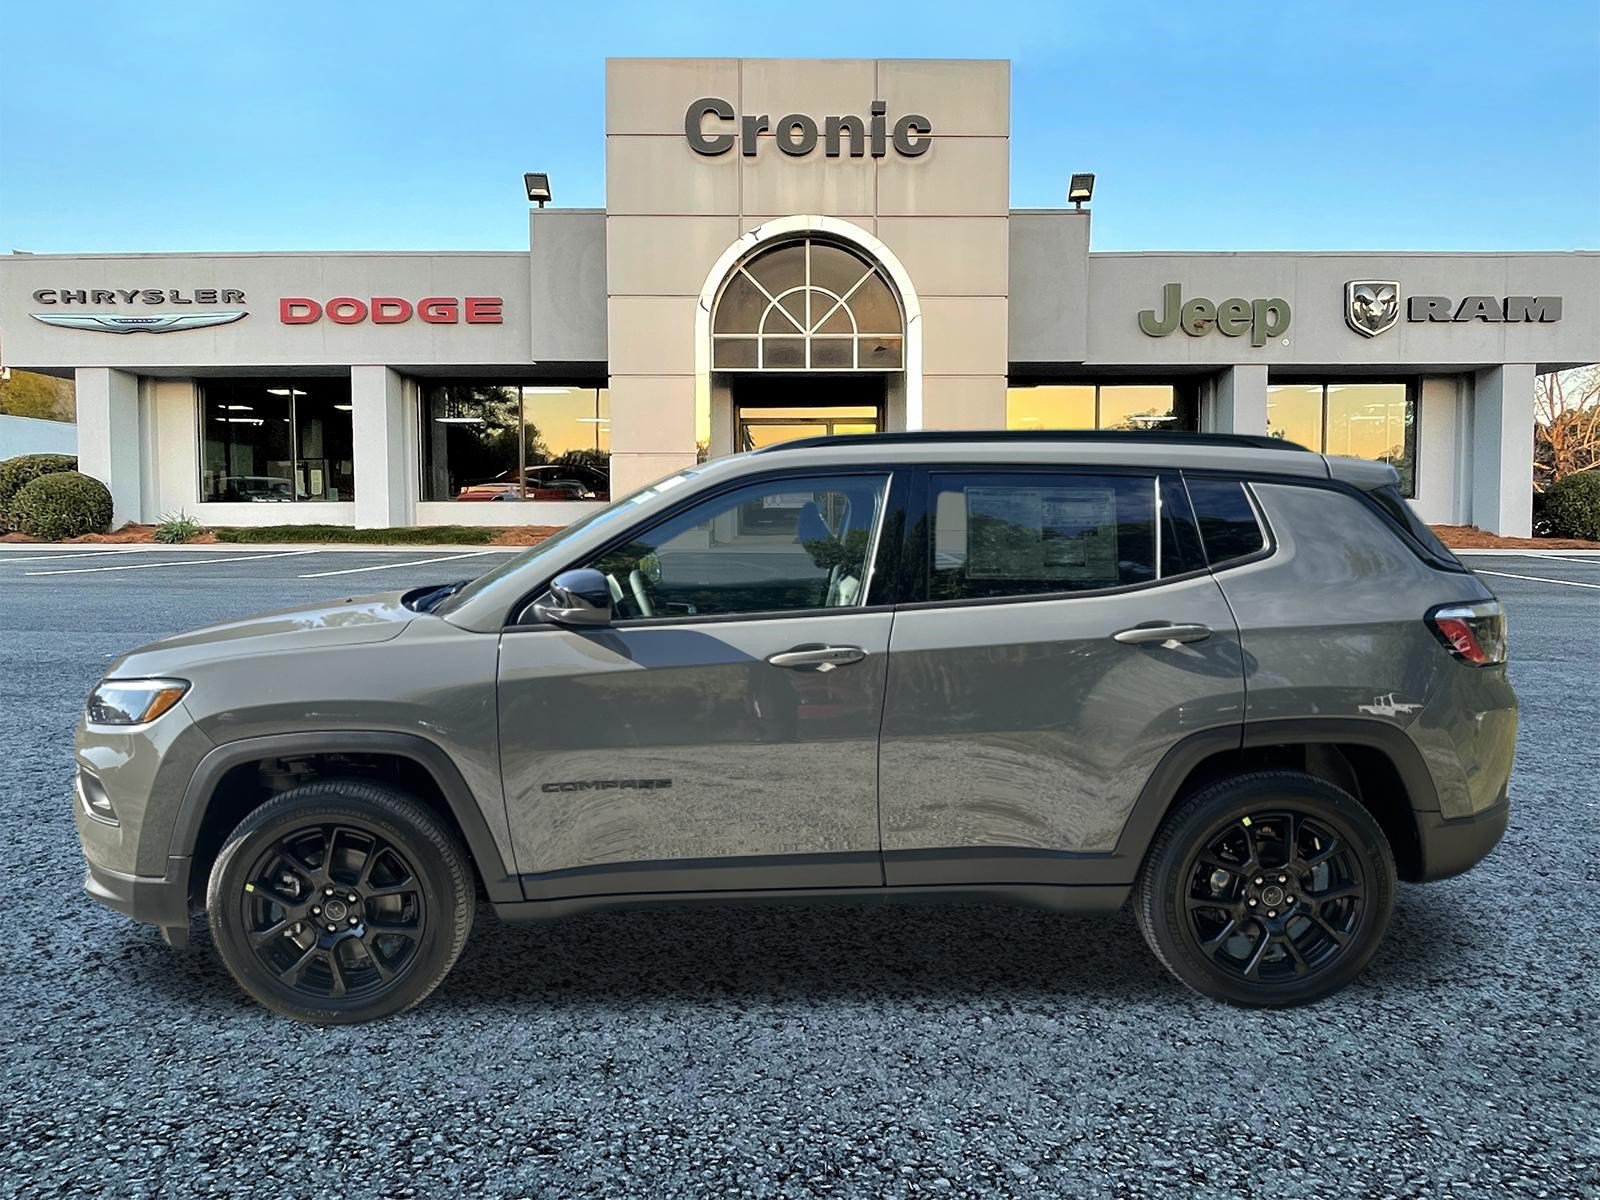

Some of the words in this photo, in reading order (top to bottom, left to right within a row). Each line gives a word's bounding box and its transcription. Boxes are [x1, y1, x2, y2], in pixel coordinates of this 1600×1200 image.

[685, 97, 932, 158] Cronic
[32, 288, 247, 305] CHRYSLER
[1407, 296, 1563, 323] RAM
[279, 297, 504, 325] DODGE
[1138, 283, 1292, 347] Jeep
